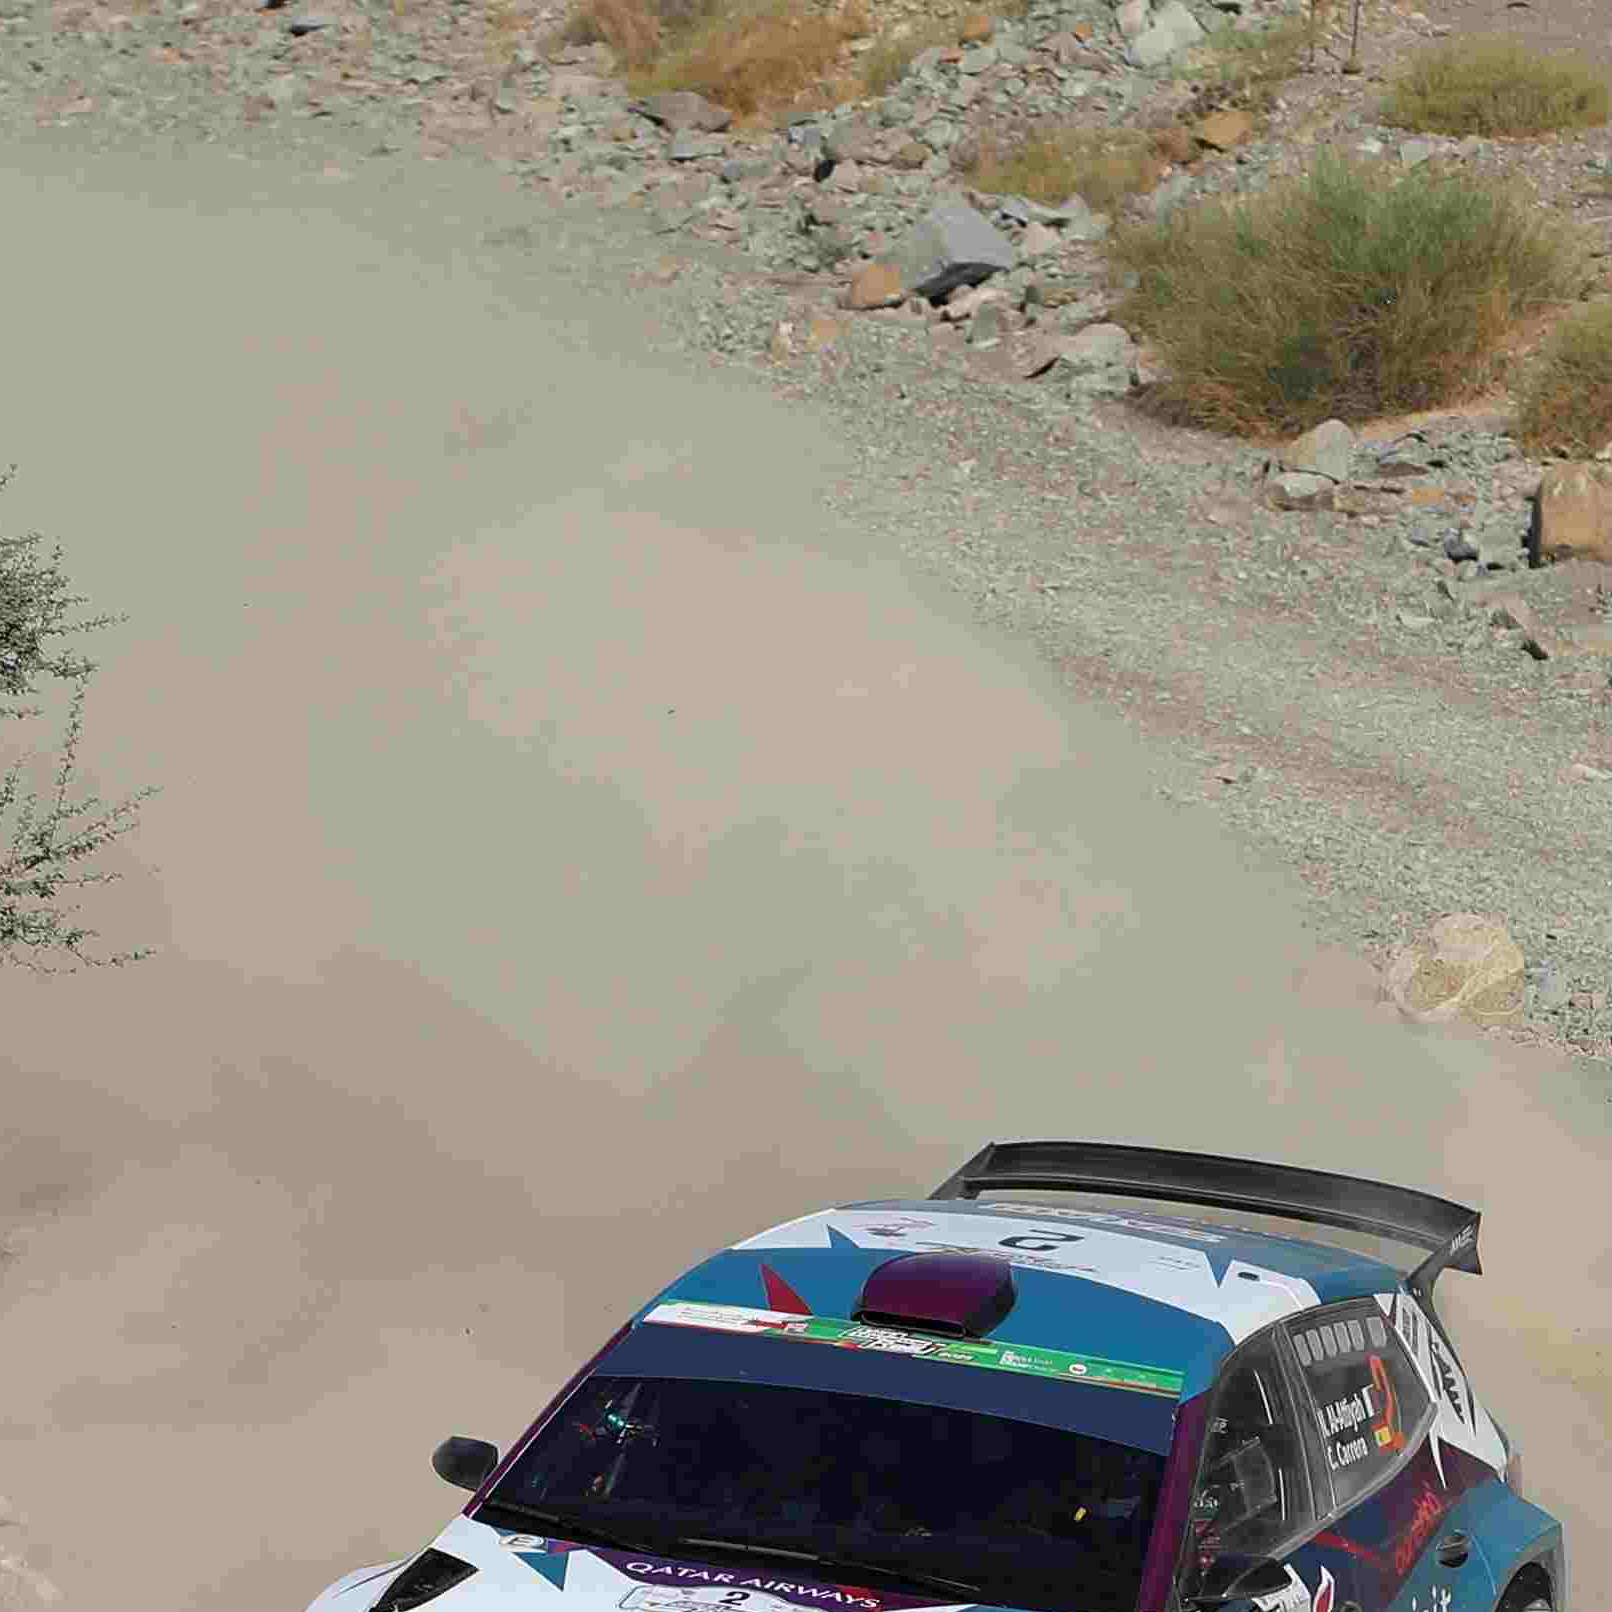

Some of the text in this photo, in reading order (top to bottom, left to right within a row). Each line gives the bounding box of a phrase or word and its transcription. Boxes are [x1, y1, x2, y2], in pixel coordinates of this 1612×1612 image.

[626, 1561, 735, 1585] QATAR
[740, 1577, 881, 1608] AIRWAYS
[719, 1591, 750, 1606] 2
